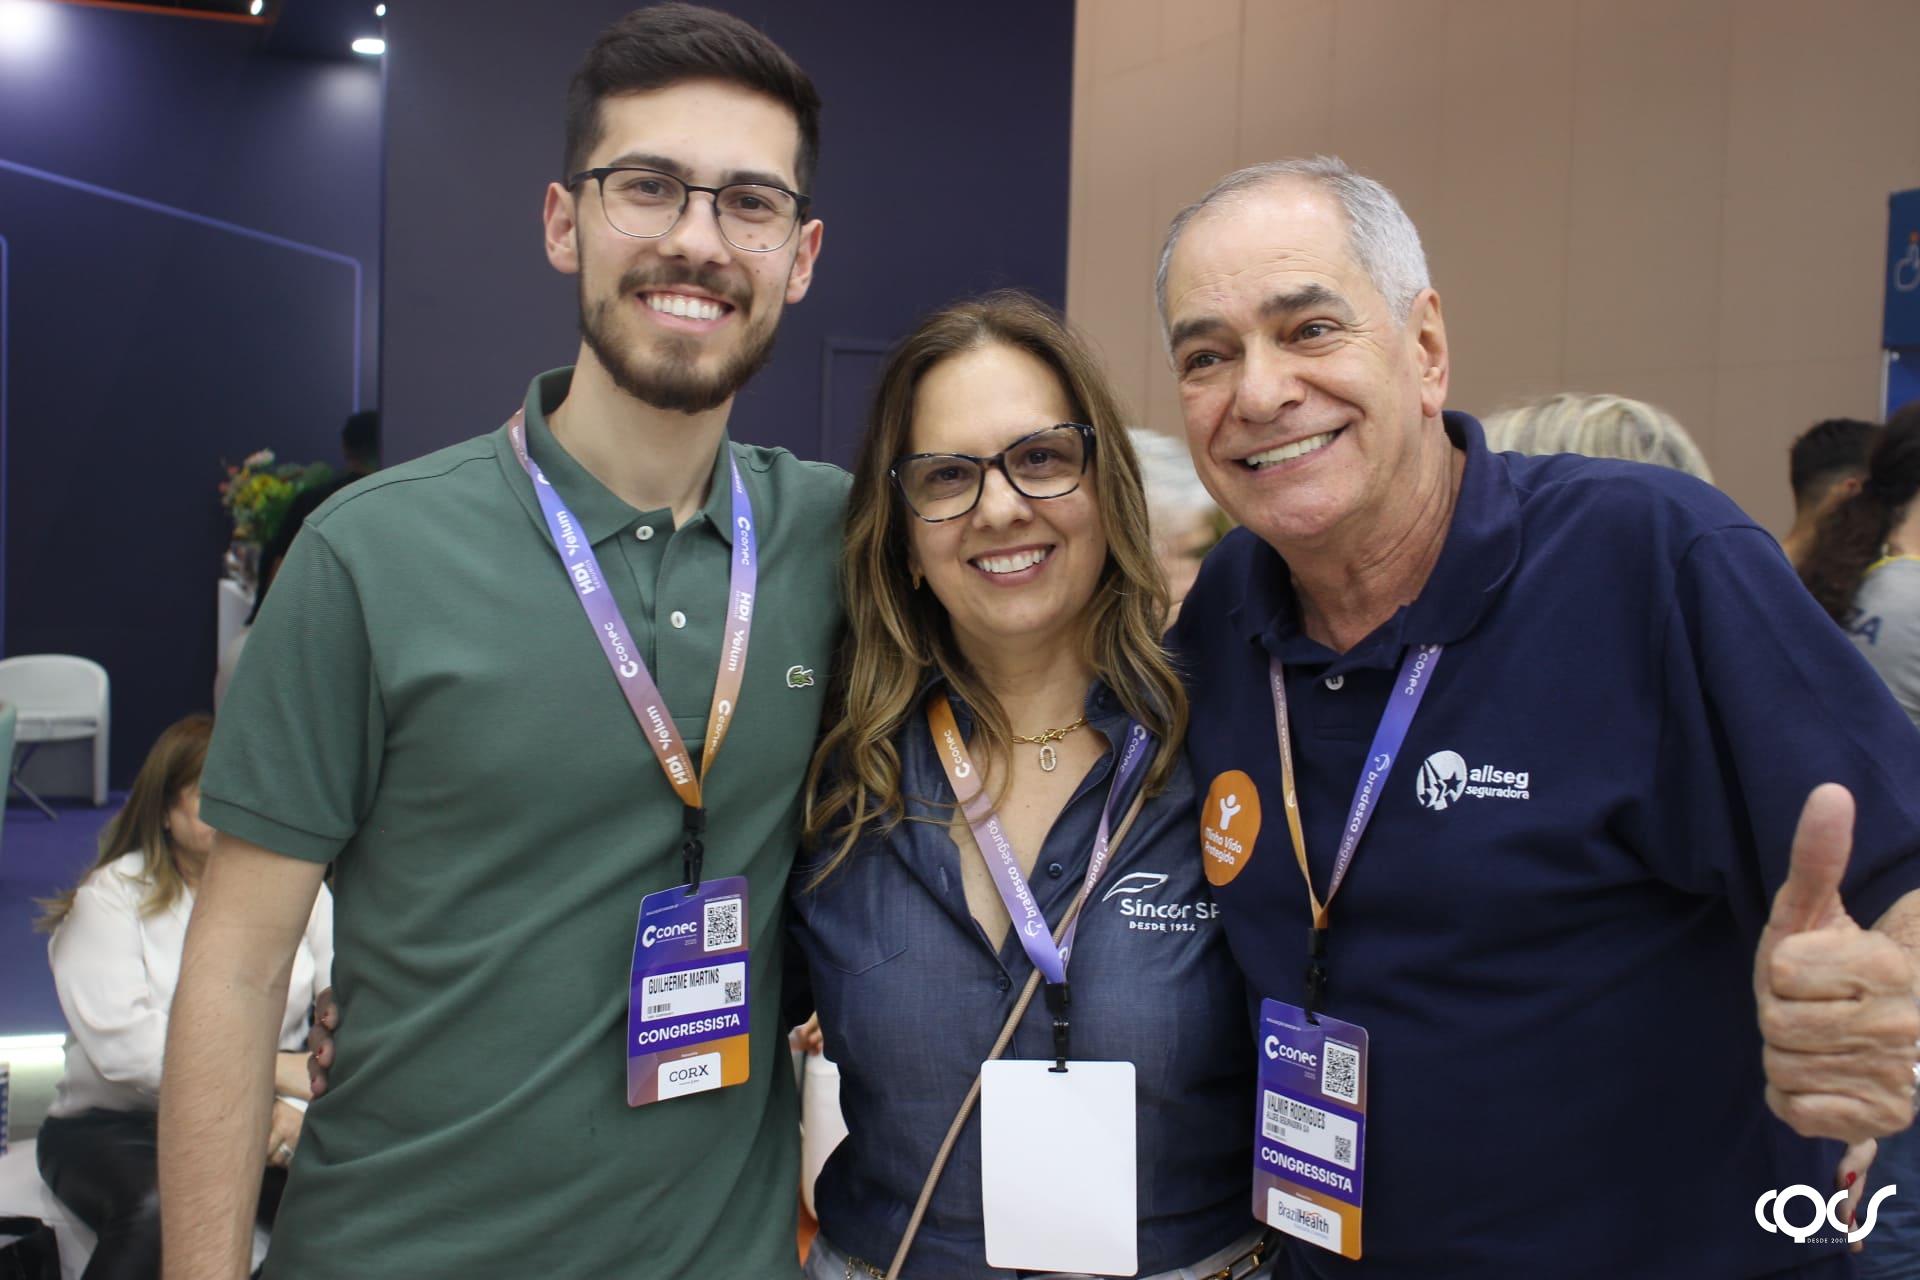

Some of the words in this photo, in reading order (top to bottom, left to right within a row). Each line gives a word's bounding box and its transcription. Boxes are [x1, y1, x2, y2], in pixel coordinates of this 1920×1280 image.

[556, 510, 580, 557] Yelum
[571, 562, 596, 595] HDI
[738, 591, 751, 622] HDI
[646, 705, 672, 752] Yelum
[664, 755, 689, 785] HDI
[1469, 765, 1529, 789] allseg
[1350, 771, 1379, 833] bradesco
[1465, 785, 1529, 800] seguradora
[986, 820, 1013, 865] seguros
[1008, 866, 1037, 919] bradesco
[1120, 898, 1191, 919] Sincor
[1129, 920, 1166, 931] DESDE
[648, 973, 688, 995] GUILHERME
[689, 968, 720, 988] MARTINS
[638, 1013, 741, 1045] CONGRESSISTA
[669, 1064, 709, 1083] CORX
[1261, 1146, 1353, 1193] CONGRESSISTA
